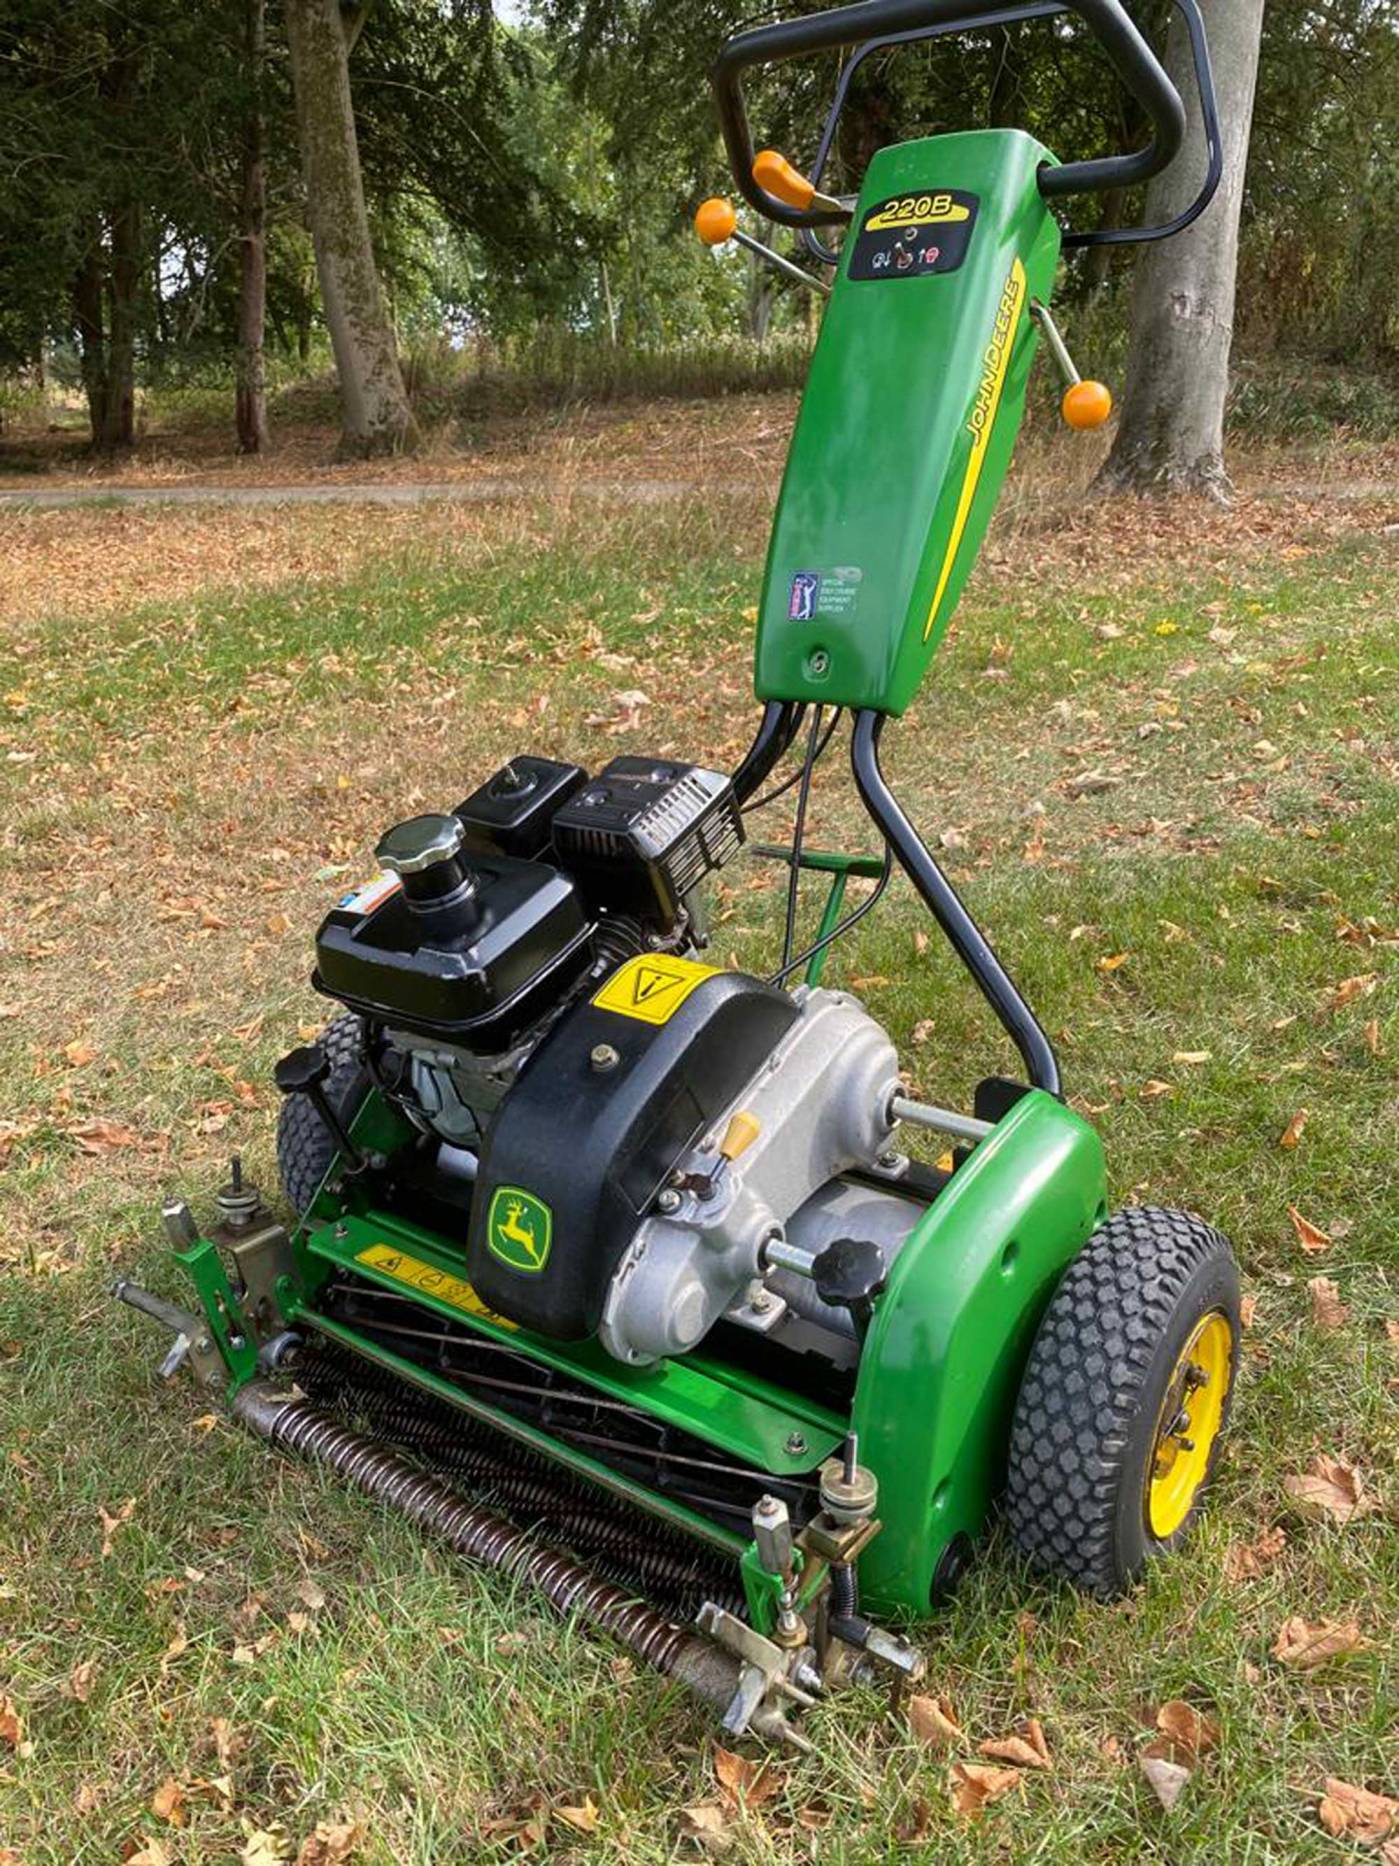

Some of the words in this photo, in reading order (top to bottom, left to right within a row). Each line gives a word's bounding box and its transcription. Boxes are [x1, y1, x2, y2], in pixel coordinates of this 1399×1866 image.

[880, 195, 952, 222] 220B
[967, 369, 998, 445] JOHN
[984, 279, 1019, 367] DEERE
